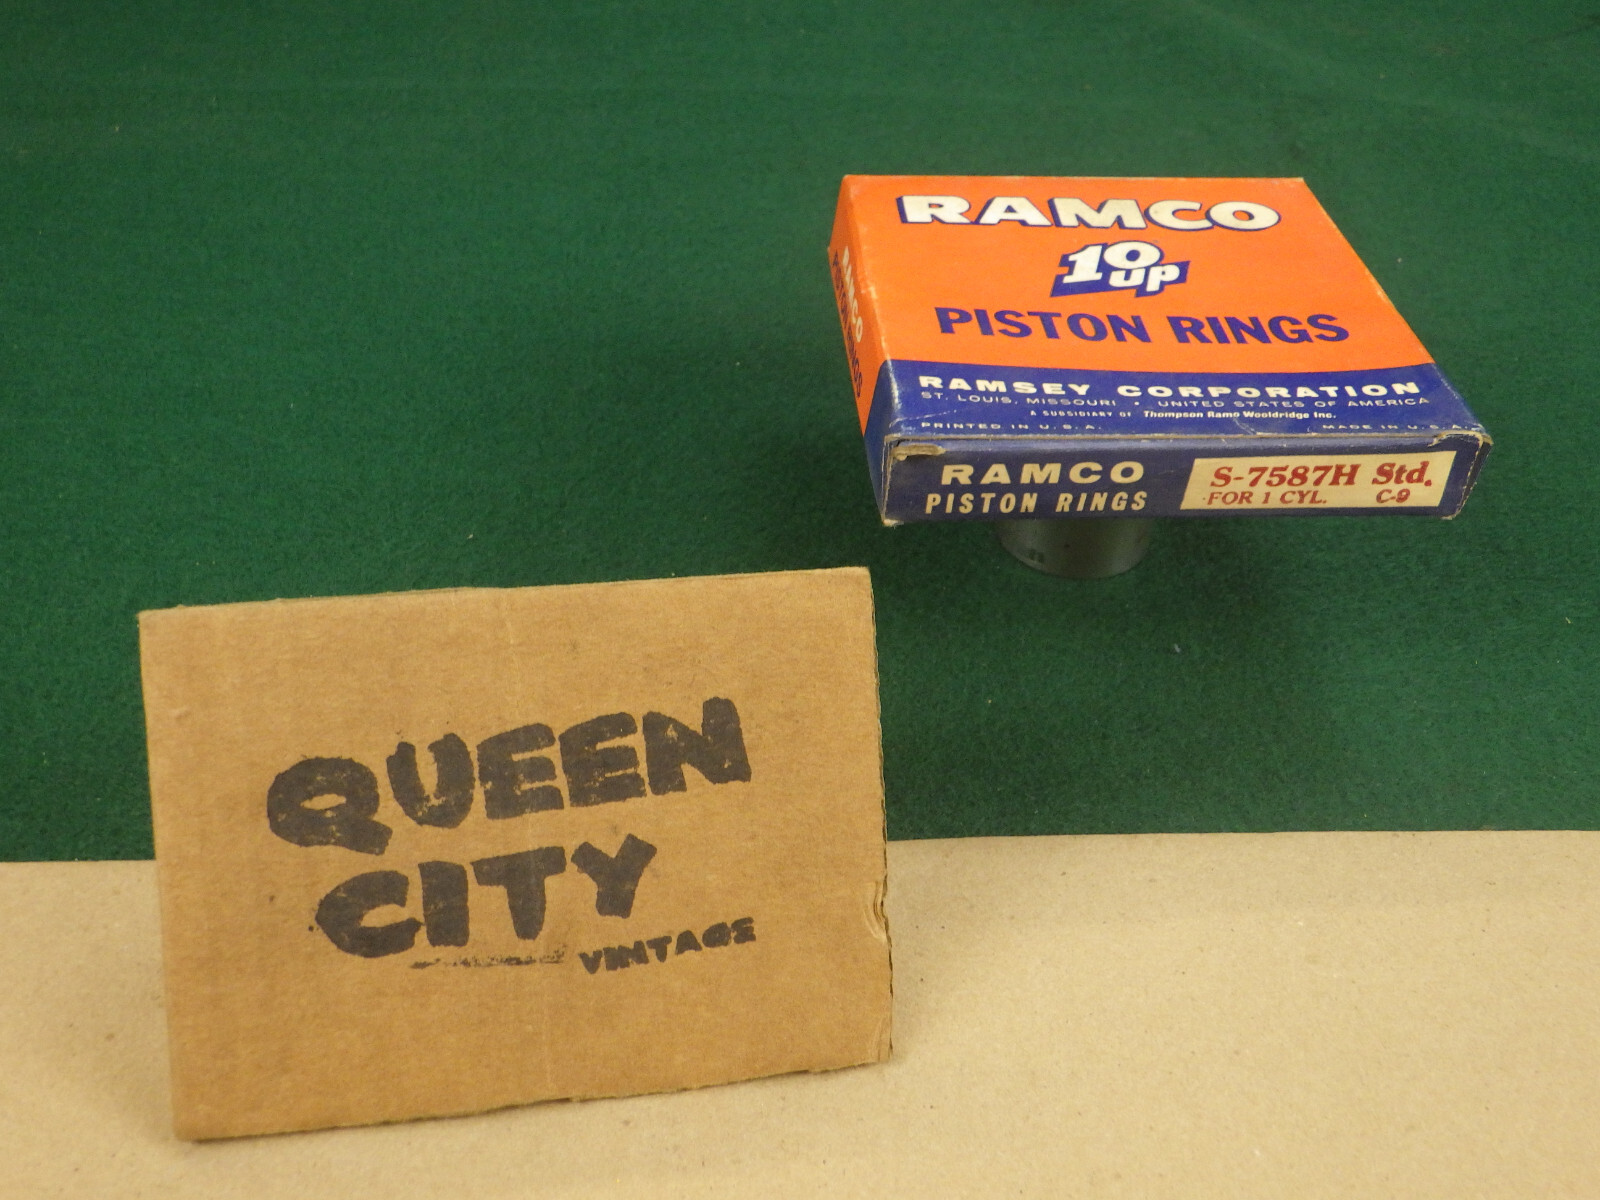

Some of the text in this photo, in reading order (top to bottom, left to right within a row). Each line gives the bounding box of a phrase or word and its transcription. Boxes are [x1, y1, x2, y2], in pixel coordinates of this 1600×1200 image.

[898, 195, 1281, 231] RAMCO
[1060, 240, 1162, 284] 10
[934, 307, 1350, 345] PISTON RINGS
[918, 375, 1420, 399] RAMSEY CORPORATION
[1026, 397, 1117, 407] MISSOURI
[1158, 399, 1225, 408] UNITED
[1233, 399, 1306, 408] STATES
[1314, 400, 1337, 408] OF
[1347, 397, 1430, 407] AMERICA
[1143, 410, 1204, 420] Thompson
[1207, 410, 1240, 419] Ramo
[1242, 410, 1310, 420] Wooldridge
[1313, 411, 1337, 419] Inc.
[921, 422, 1001, 430] PRINTED
[941, 461, 1145, 486] RAMCO
[1210, 461, 1433, 488] S-7587H Std.
[925, 491, 1148, 515] PISTON RINGS
[1207, 491, 1254, 506] FOR
[1279, 490, 1328, 505] CYL.
[1375, 488, 1411, 504] C-9
[267, 697, 752, 856] QUEEN
[315, 833, 657, 958] CITY
[579, 917, 757, 974] VINTAGE
